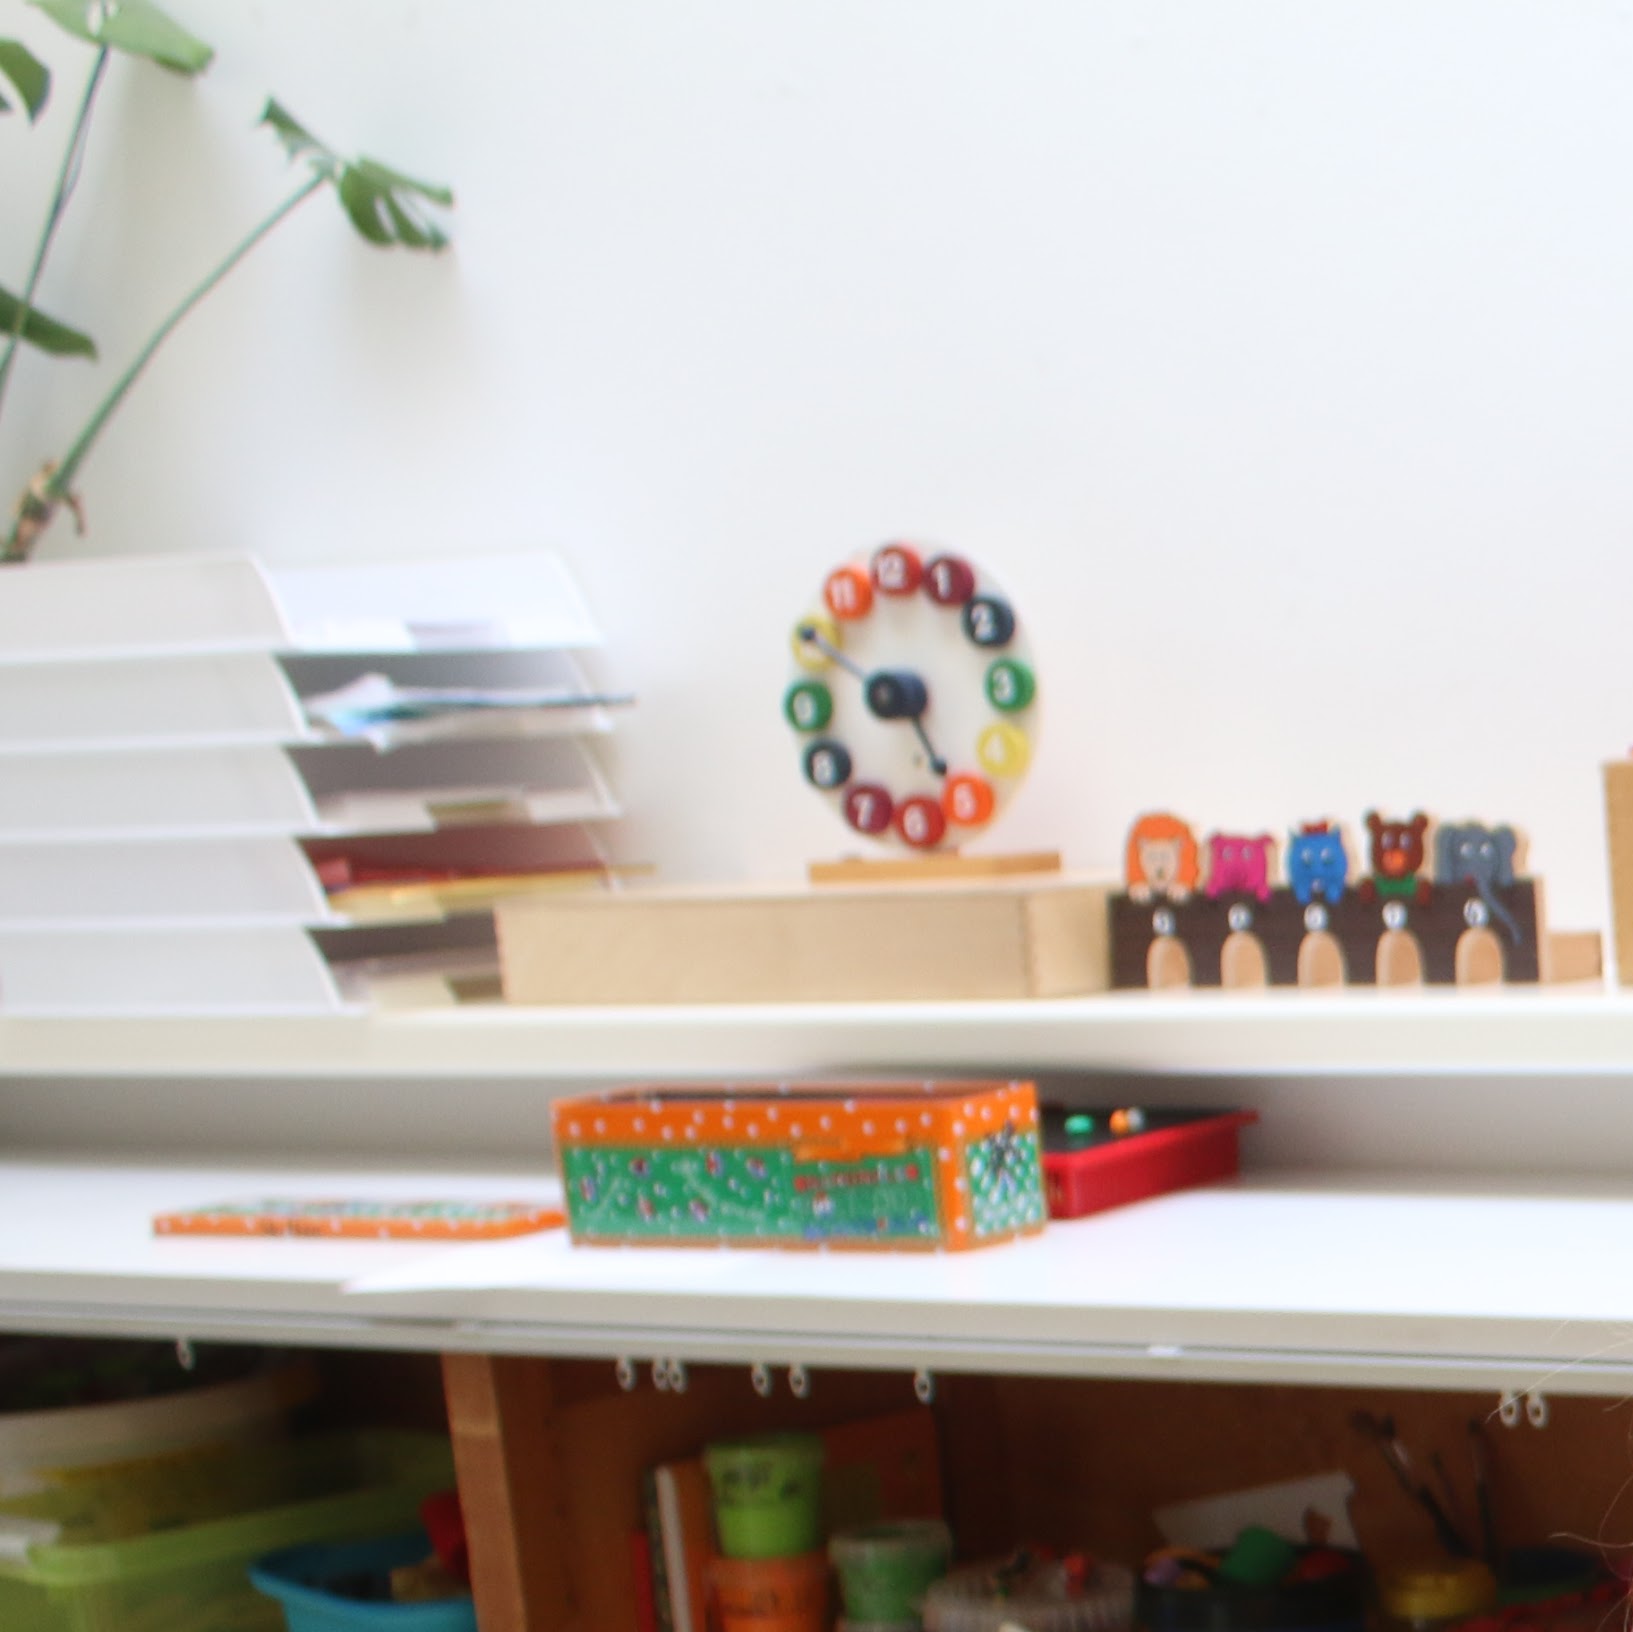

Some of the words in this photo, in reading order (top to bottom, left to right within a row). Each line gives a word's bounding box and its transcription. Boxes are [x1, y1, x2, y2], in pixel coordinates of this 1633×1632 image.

[877, 553, 905, 590] 12
[934, 562, 952, 598] 1
[832, 578, 856, 612] 11
[971, 604, 994, 640] 2
[994, 667, 1014, 702] 3
[983, 733, 1004, 762] 4
[856, 800, 875, 832] 7
